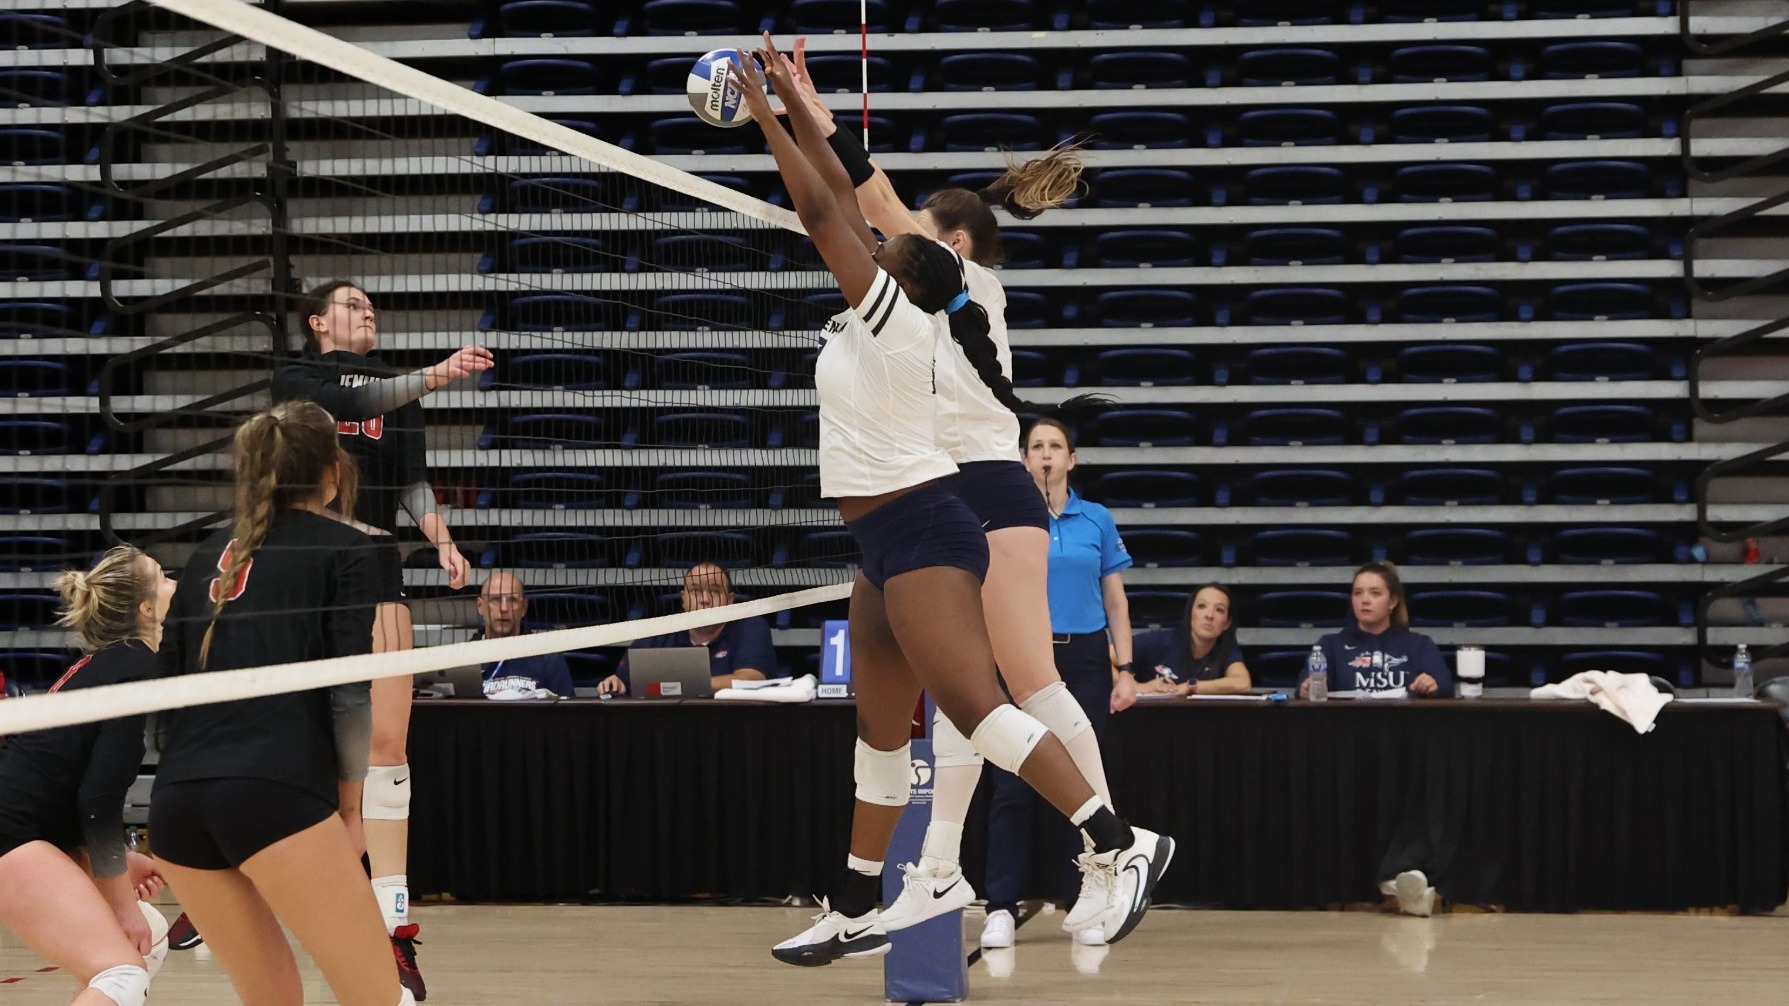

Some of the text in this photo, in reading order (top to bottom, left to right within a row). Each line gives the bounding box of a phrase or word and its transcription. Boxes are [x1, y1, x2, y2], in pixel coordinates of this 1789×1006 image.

[711, 67, 725, 111] molten
[830, 629, 846, 676] 1
[821, 686, 843, 695] HOME
[1355, 670, 1405, 688] MSU
